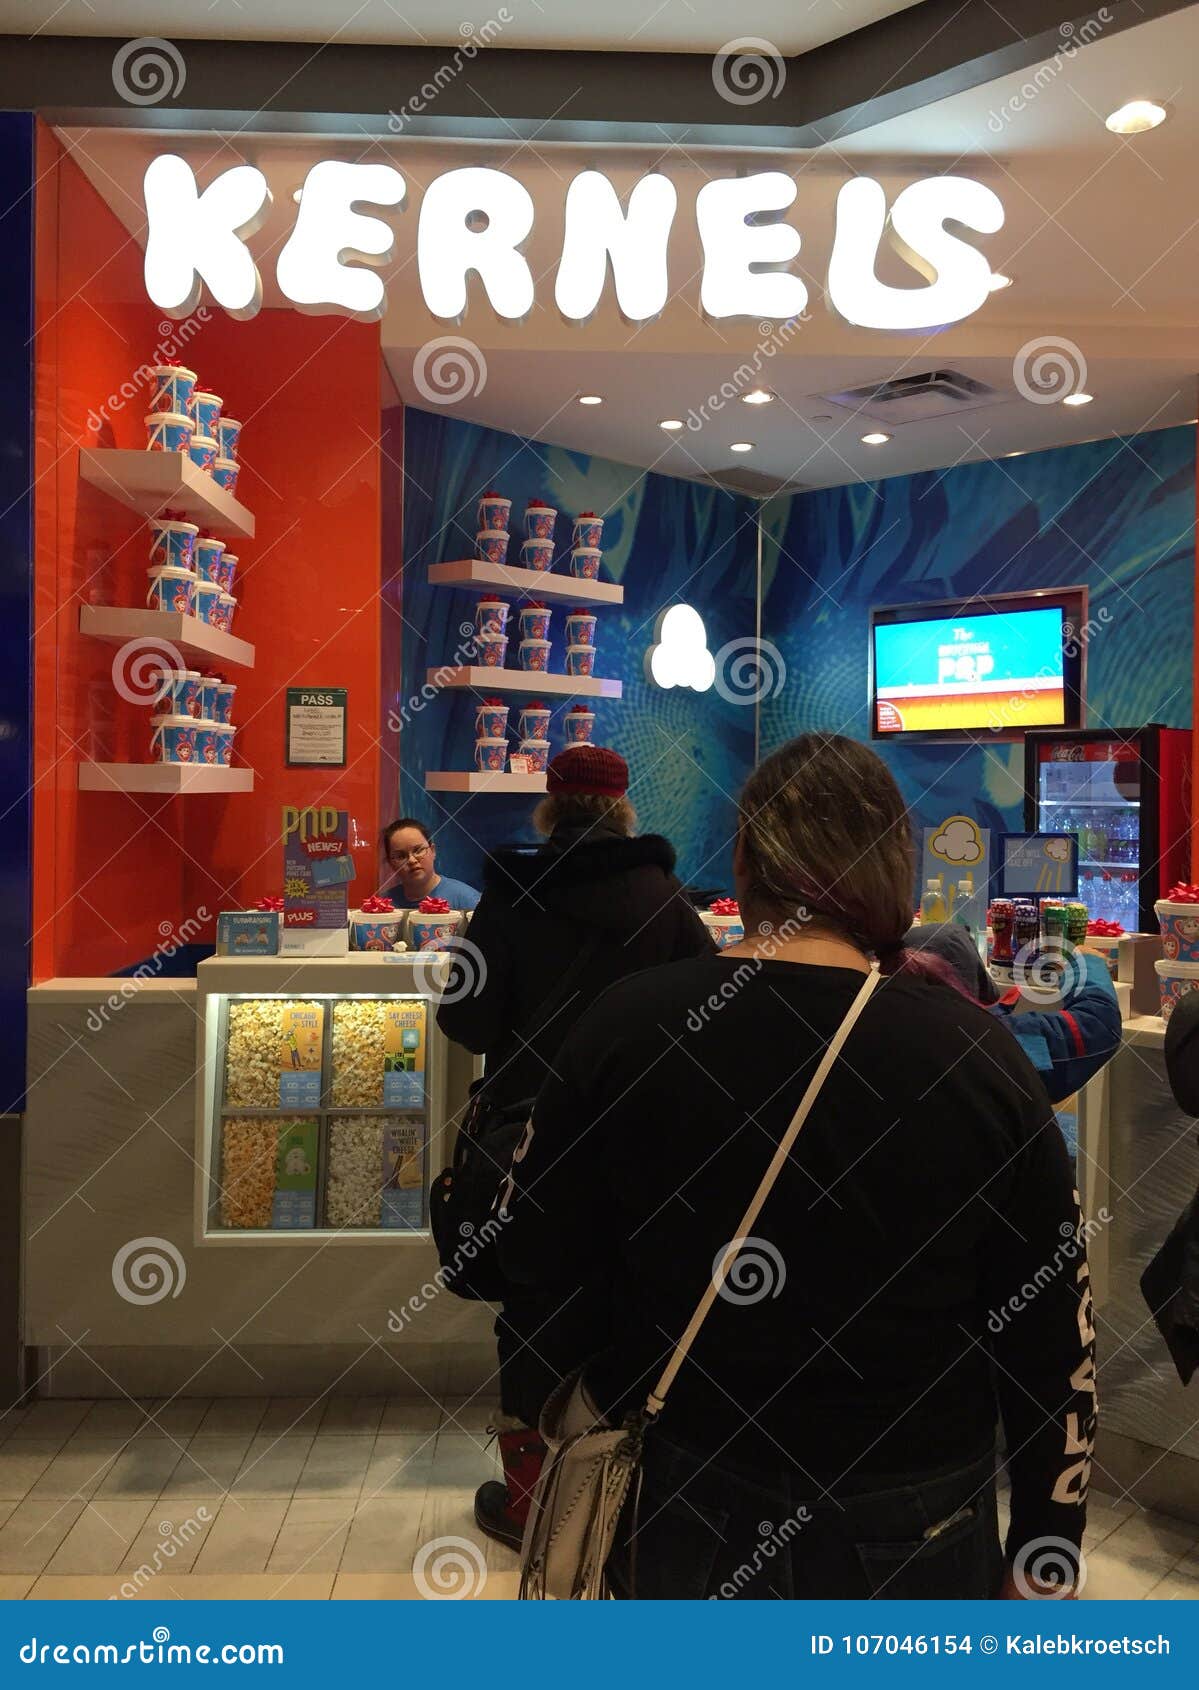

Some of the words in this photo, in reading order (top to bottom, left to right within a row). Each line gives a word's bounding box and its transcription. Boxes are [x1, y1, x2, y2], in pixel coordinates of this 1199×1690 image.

[143, 154, 1005, 330] KERNELS
[301, 694, 334, 706] PASS
[307, 841, 343, 853] NEWS!
[287, 911, 313, 922] PLUS
[290, 1011, 316, 1020] CHICAGO
[400, 1011, 422, 1020] CHEESE
[394, 1020, 416, 1028] CHEESE
